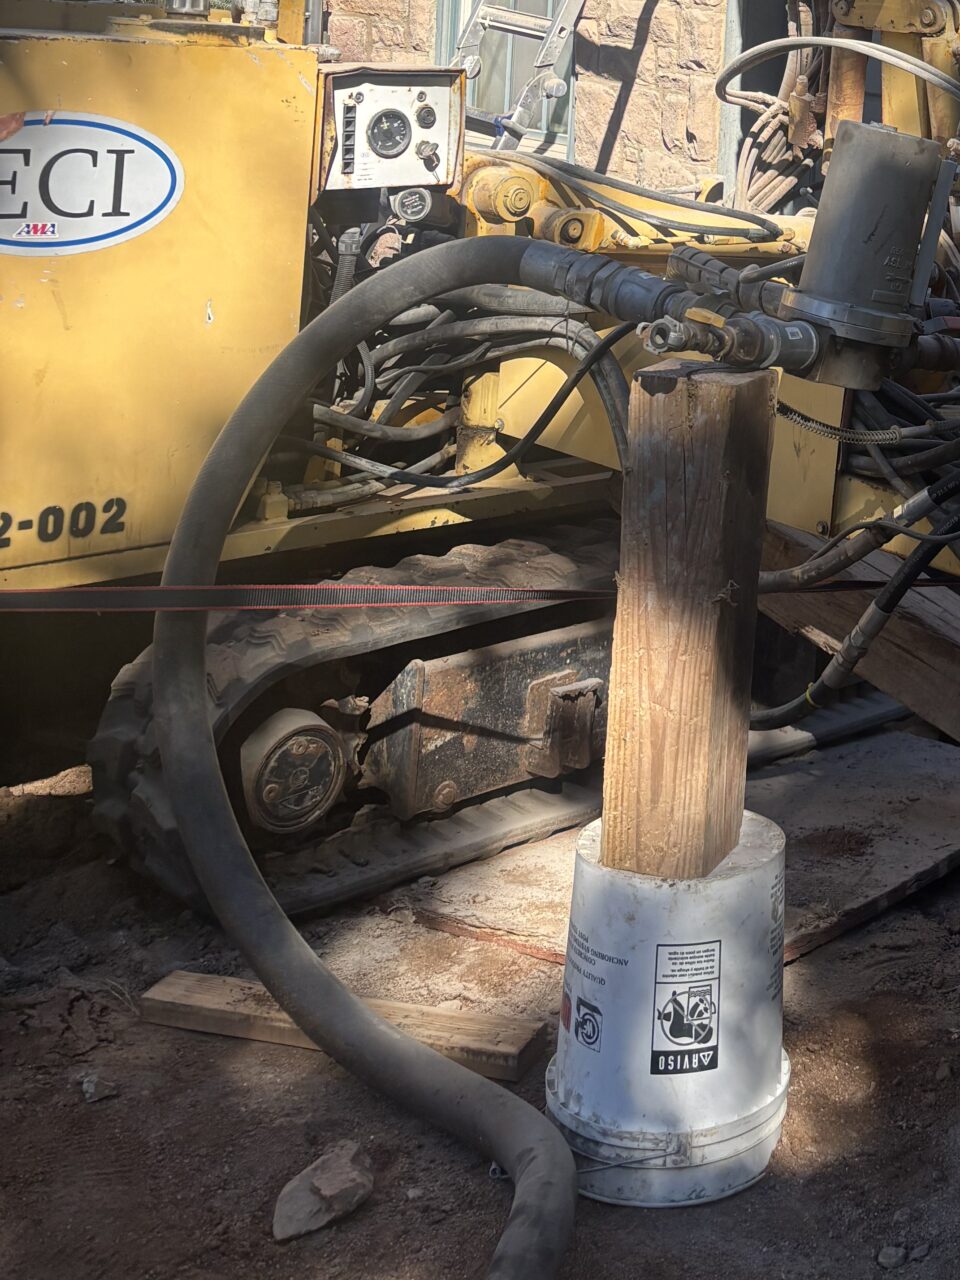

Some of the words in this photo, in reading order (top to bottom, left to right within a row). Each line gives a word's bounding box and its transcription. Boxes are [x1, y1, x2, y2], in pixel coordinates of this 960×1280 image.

[0, 148, 135, 219] ECI
[17, 223, 56, 235] AMA
[590, 948, 629, 966] ANCHORING
[658, 1054, 698, 1070] AVISO
